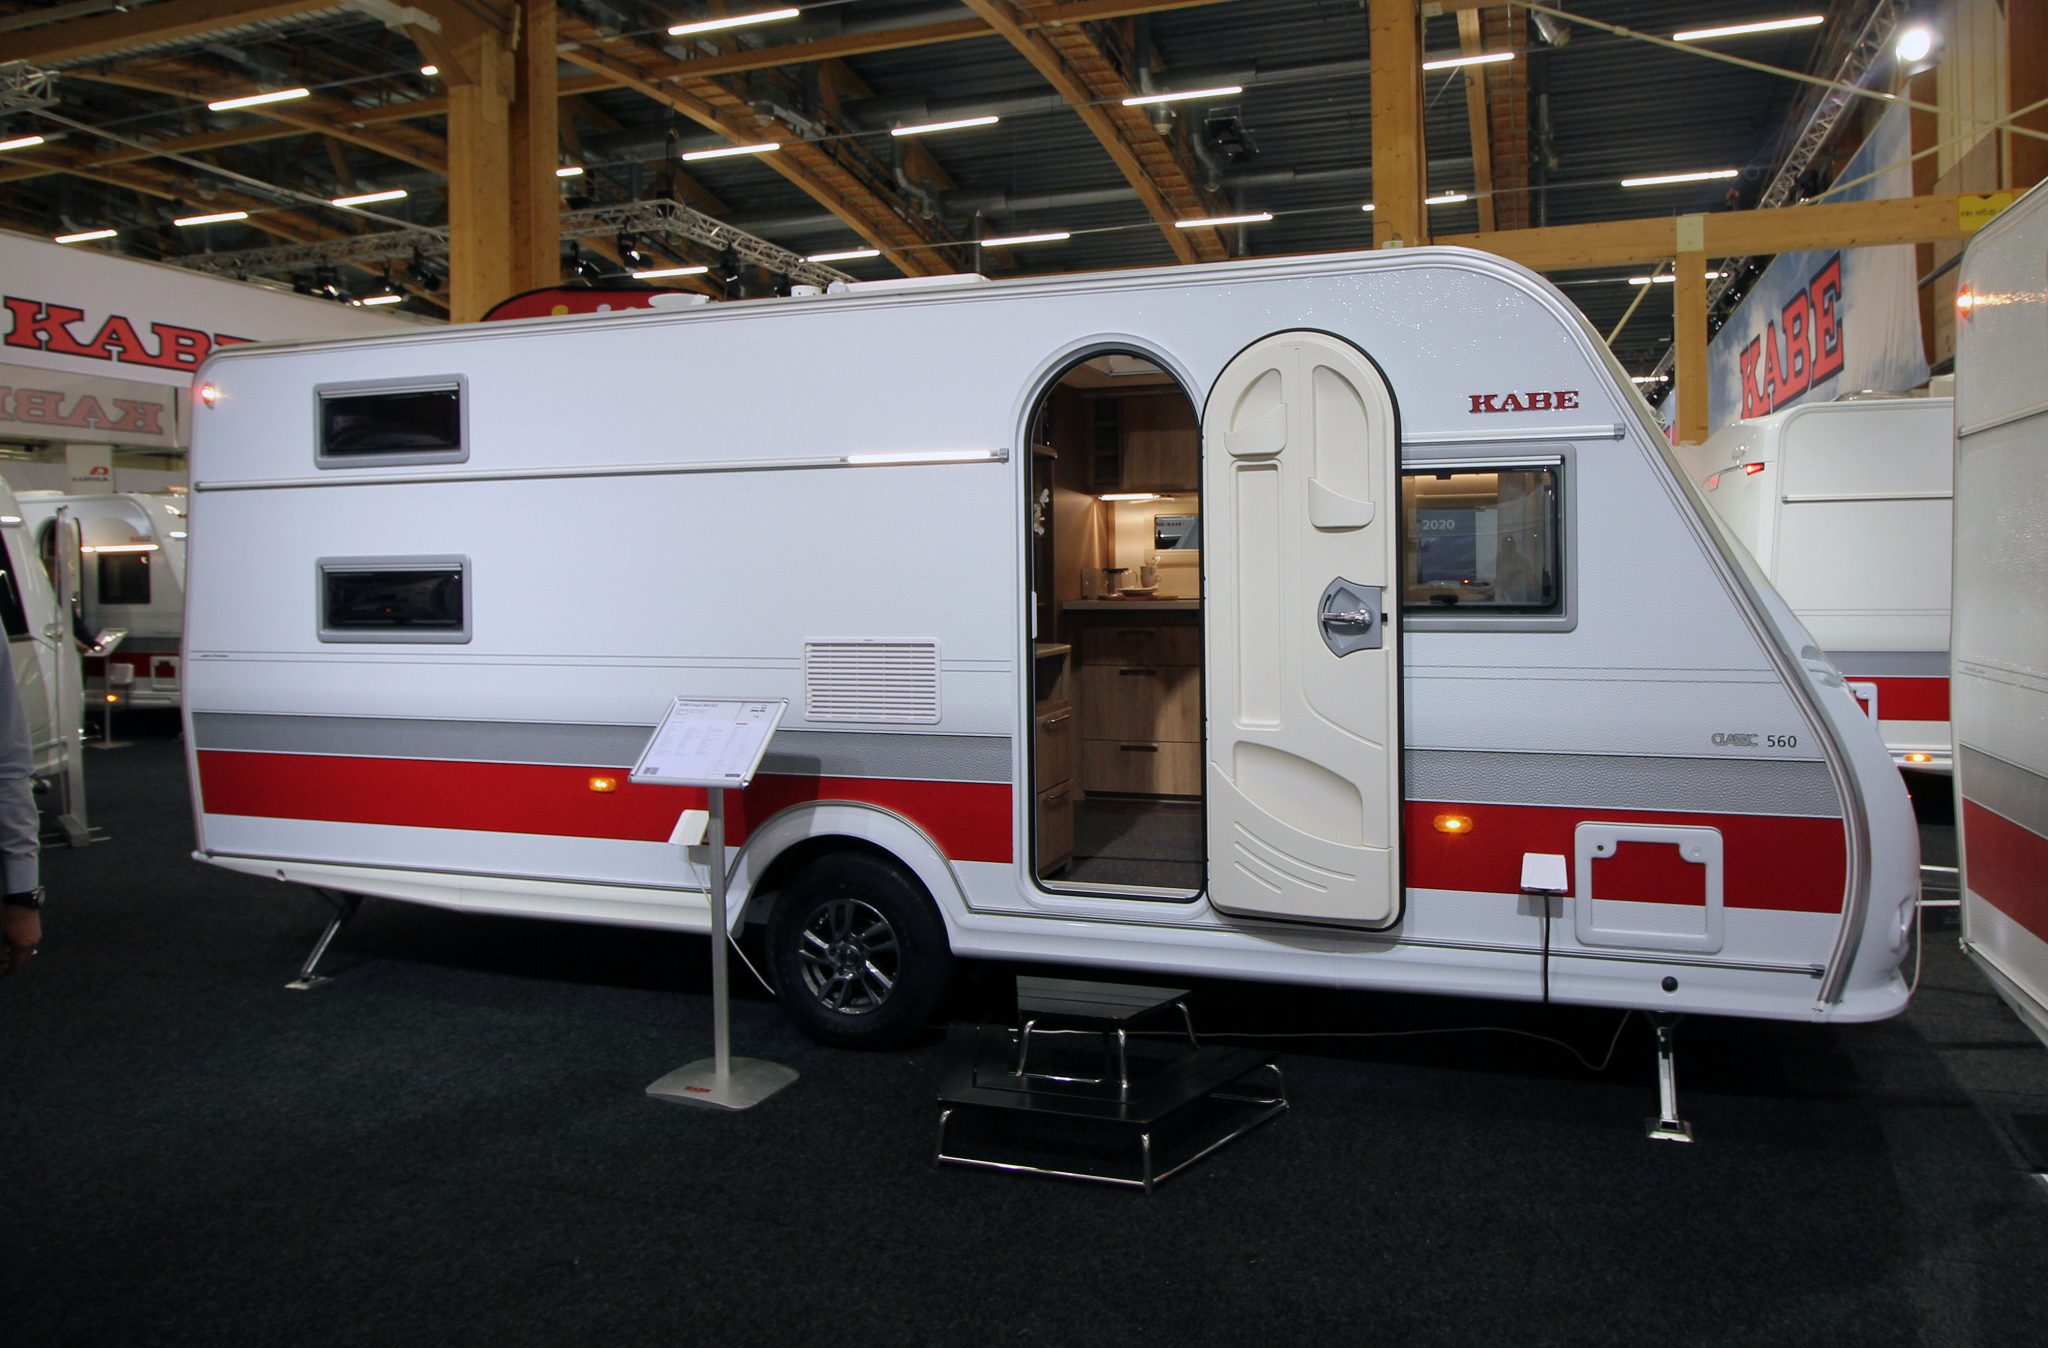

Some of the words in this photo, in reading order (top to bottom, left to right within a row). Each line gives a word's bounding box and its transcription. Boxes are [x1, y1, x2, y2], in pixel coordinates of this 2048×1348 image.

[4, 296, 260, 372] KAB
[1740, 252, 1845, 419] KABE
[1468, 390, 1579, 414] KABE
[1422, 519, 1455, 530] 2020
[1711, 733, 1759, 747] CLASSIC
[1767, 735, 1797, 748] 560
